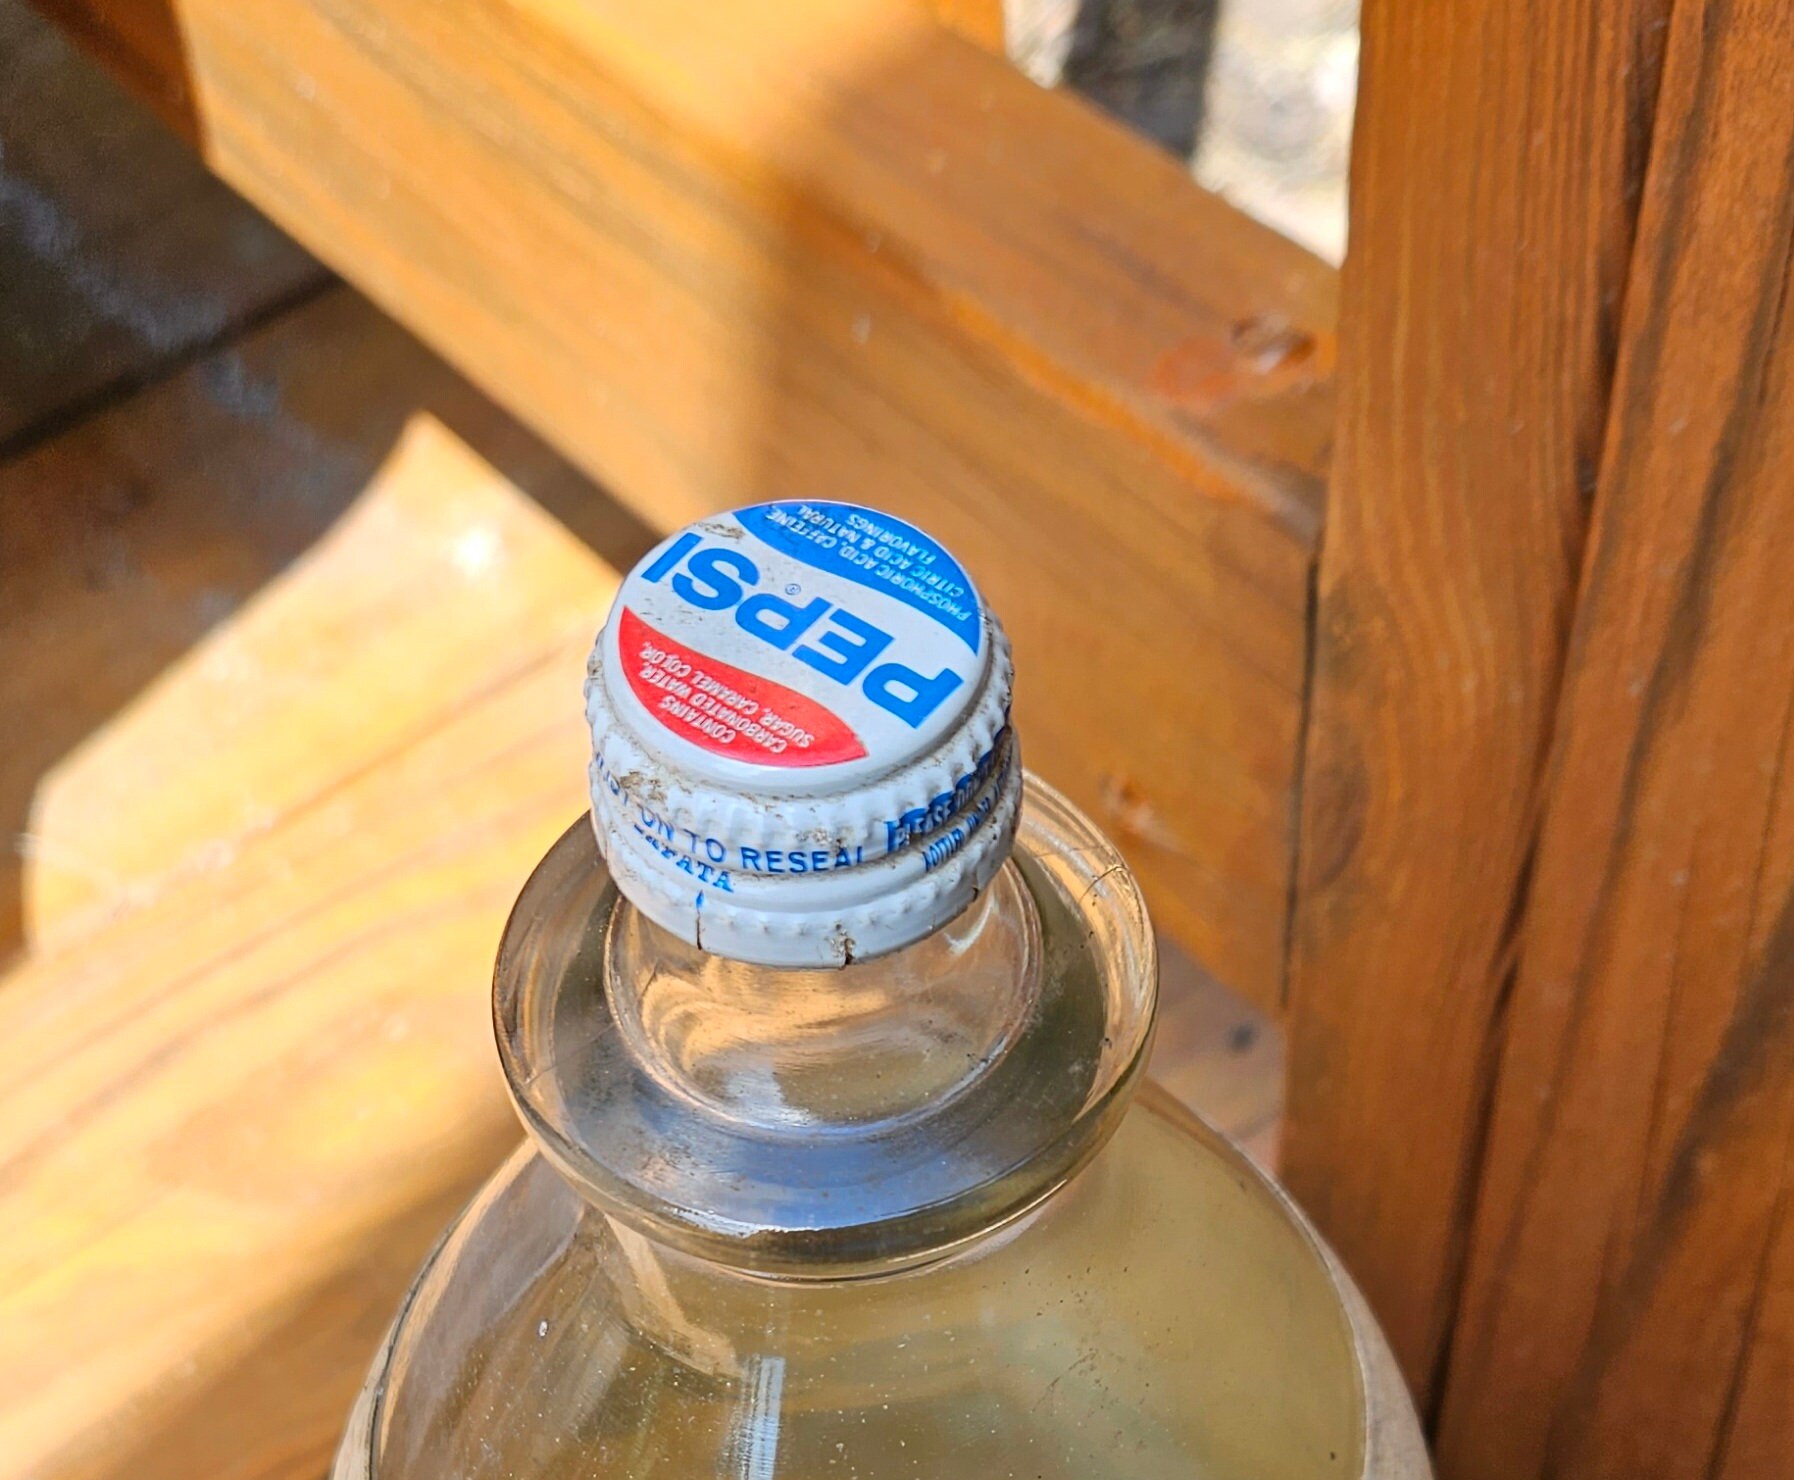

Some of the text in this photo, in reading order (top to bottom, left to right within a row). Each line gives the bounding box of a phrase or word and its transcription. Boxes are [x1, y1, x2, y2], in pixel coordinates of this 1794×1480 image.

[797, 505, 964, 598] CITRIC ACID & NATURAL
[847, 513, 937, 565] FLAVORINGS
[875, 564, 973, 621] PHOSPHORIC
[641, 532, 963, 729] PEPSI
[691, 670, 759, 715] CARAMEL
[659, 695, 736, 744] CONTAINS
[689, 692, 787, 753] CARBONATED
[760, 708, 814, 748] SUGAR,
[683, 828, 727, 863] TO
[740, 845, 863, 874] RESEAL
